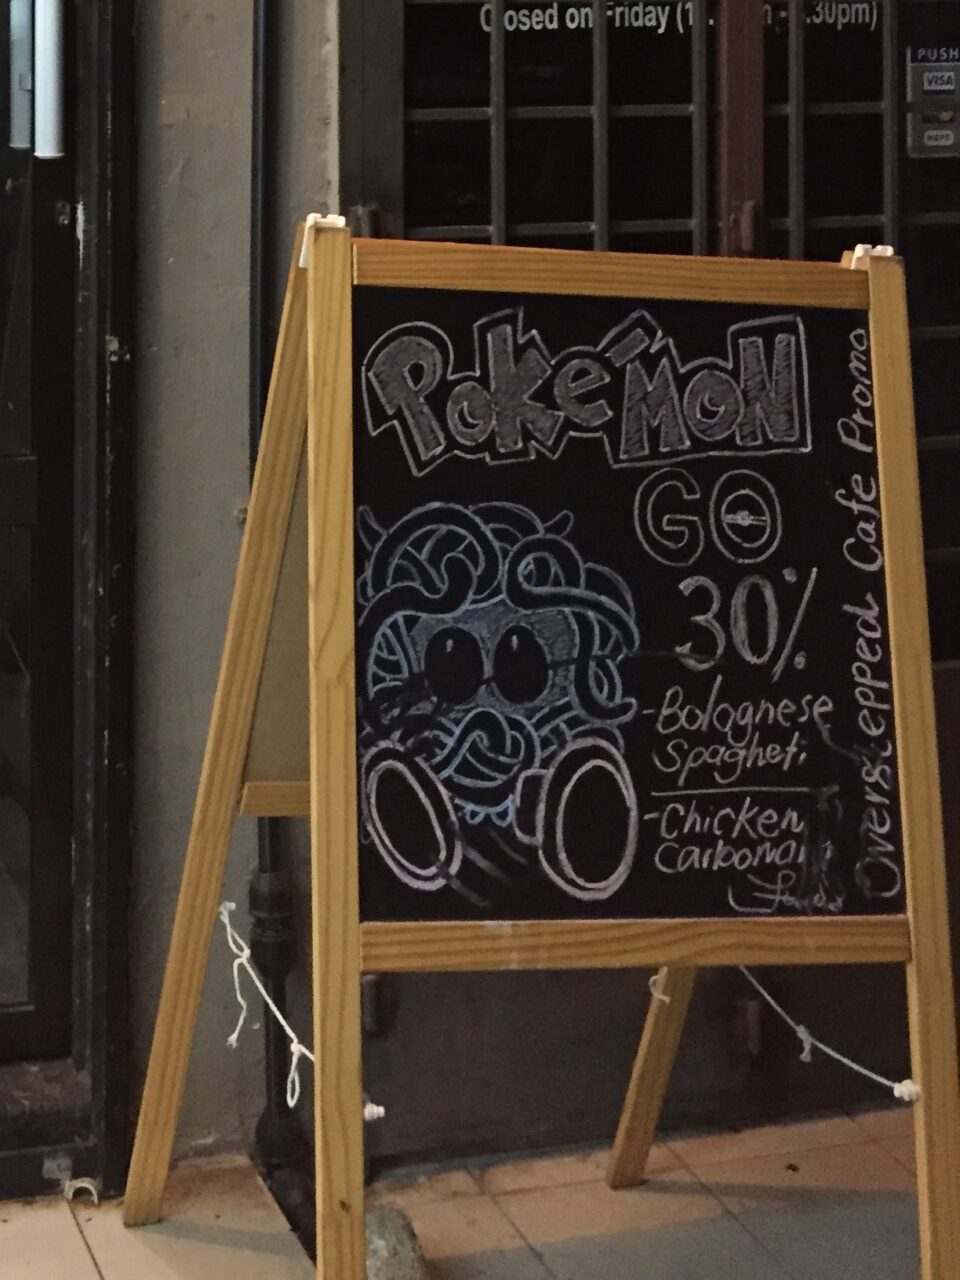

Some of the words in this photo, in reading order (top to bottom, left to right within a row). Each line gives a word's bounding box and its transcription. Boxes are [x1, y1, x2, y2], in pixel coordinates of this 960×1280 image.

[480, 1, 559, 33] Cosed
[565, 6, 593, 30] on
[917, 47, 960, 60] PUSH
[926, 74, 953, 87] VISA
[837, 328, 873, 453] Promo
[634, 467, 782, 566] GO
[836, 472, 883, 571] Cafe
[675, 567, 818, 683] 30%
